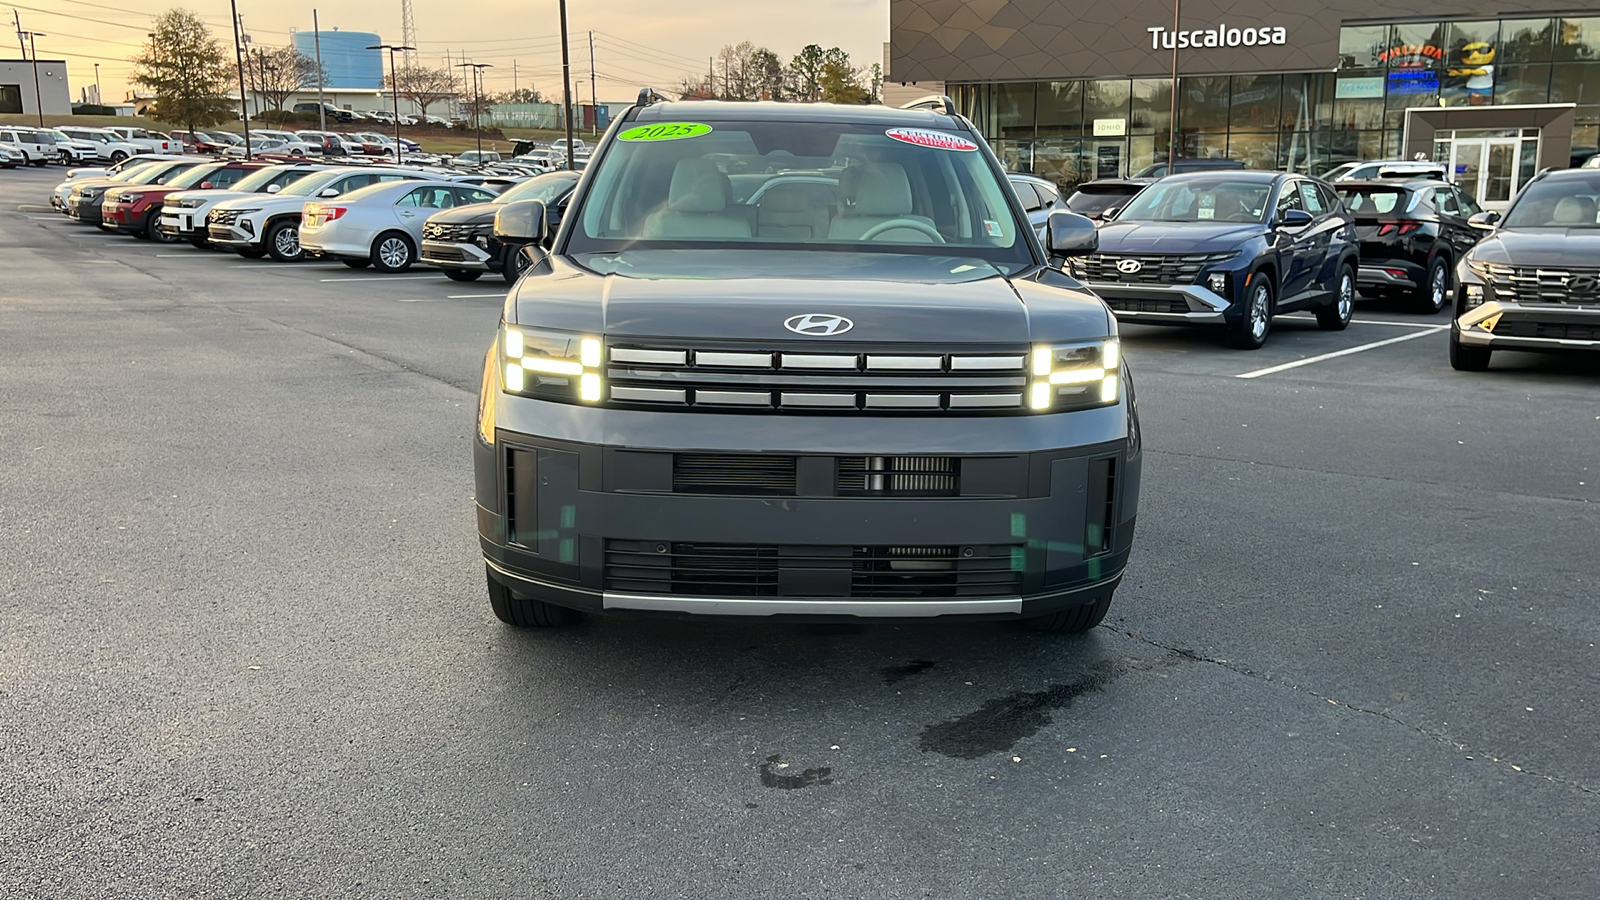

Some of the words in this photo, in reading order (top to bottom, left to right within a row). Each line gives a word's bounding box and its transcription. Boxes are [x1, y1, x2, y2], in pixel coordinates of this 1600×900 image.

[1147, 23, 1287, 50] Tuscaloosa
[631, 124, 699, 139] 2025
[896, 129, 967, 144] CERTIFIED
